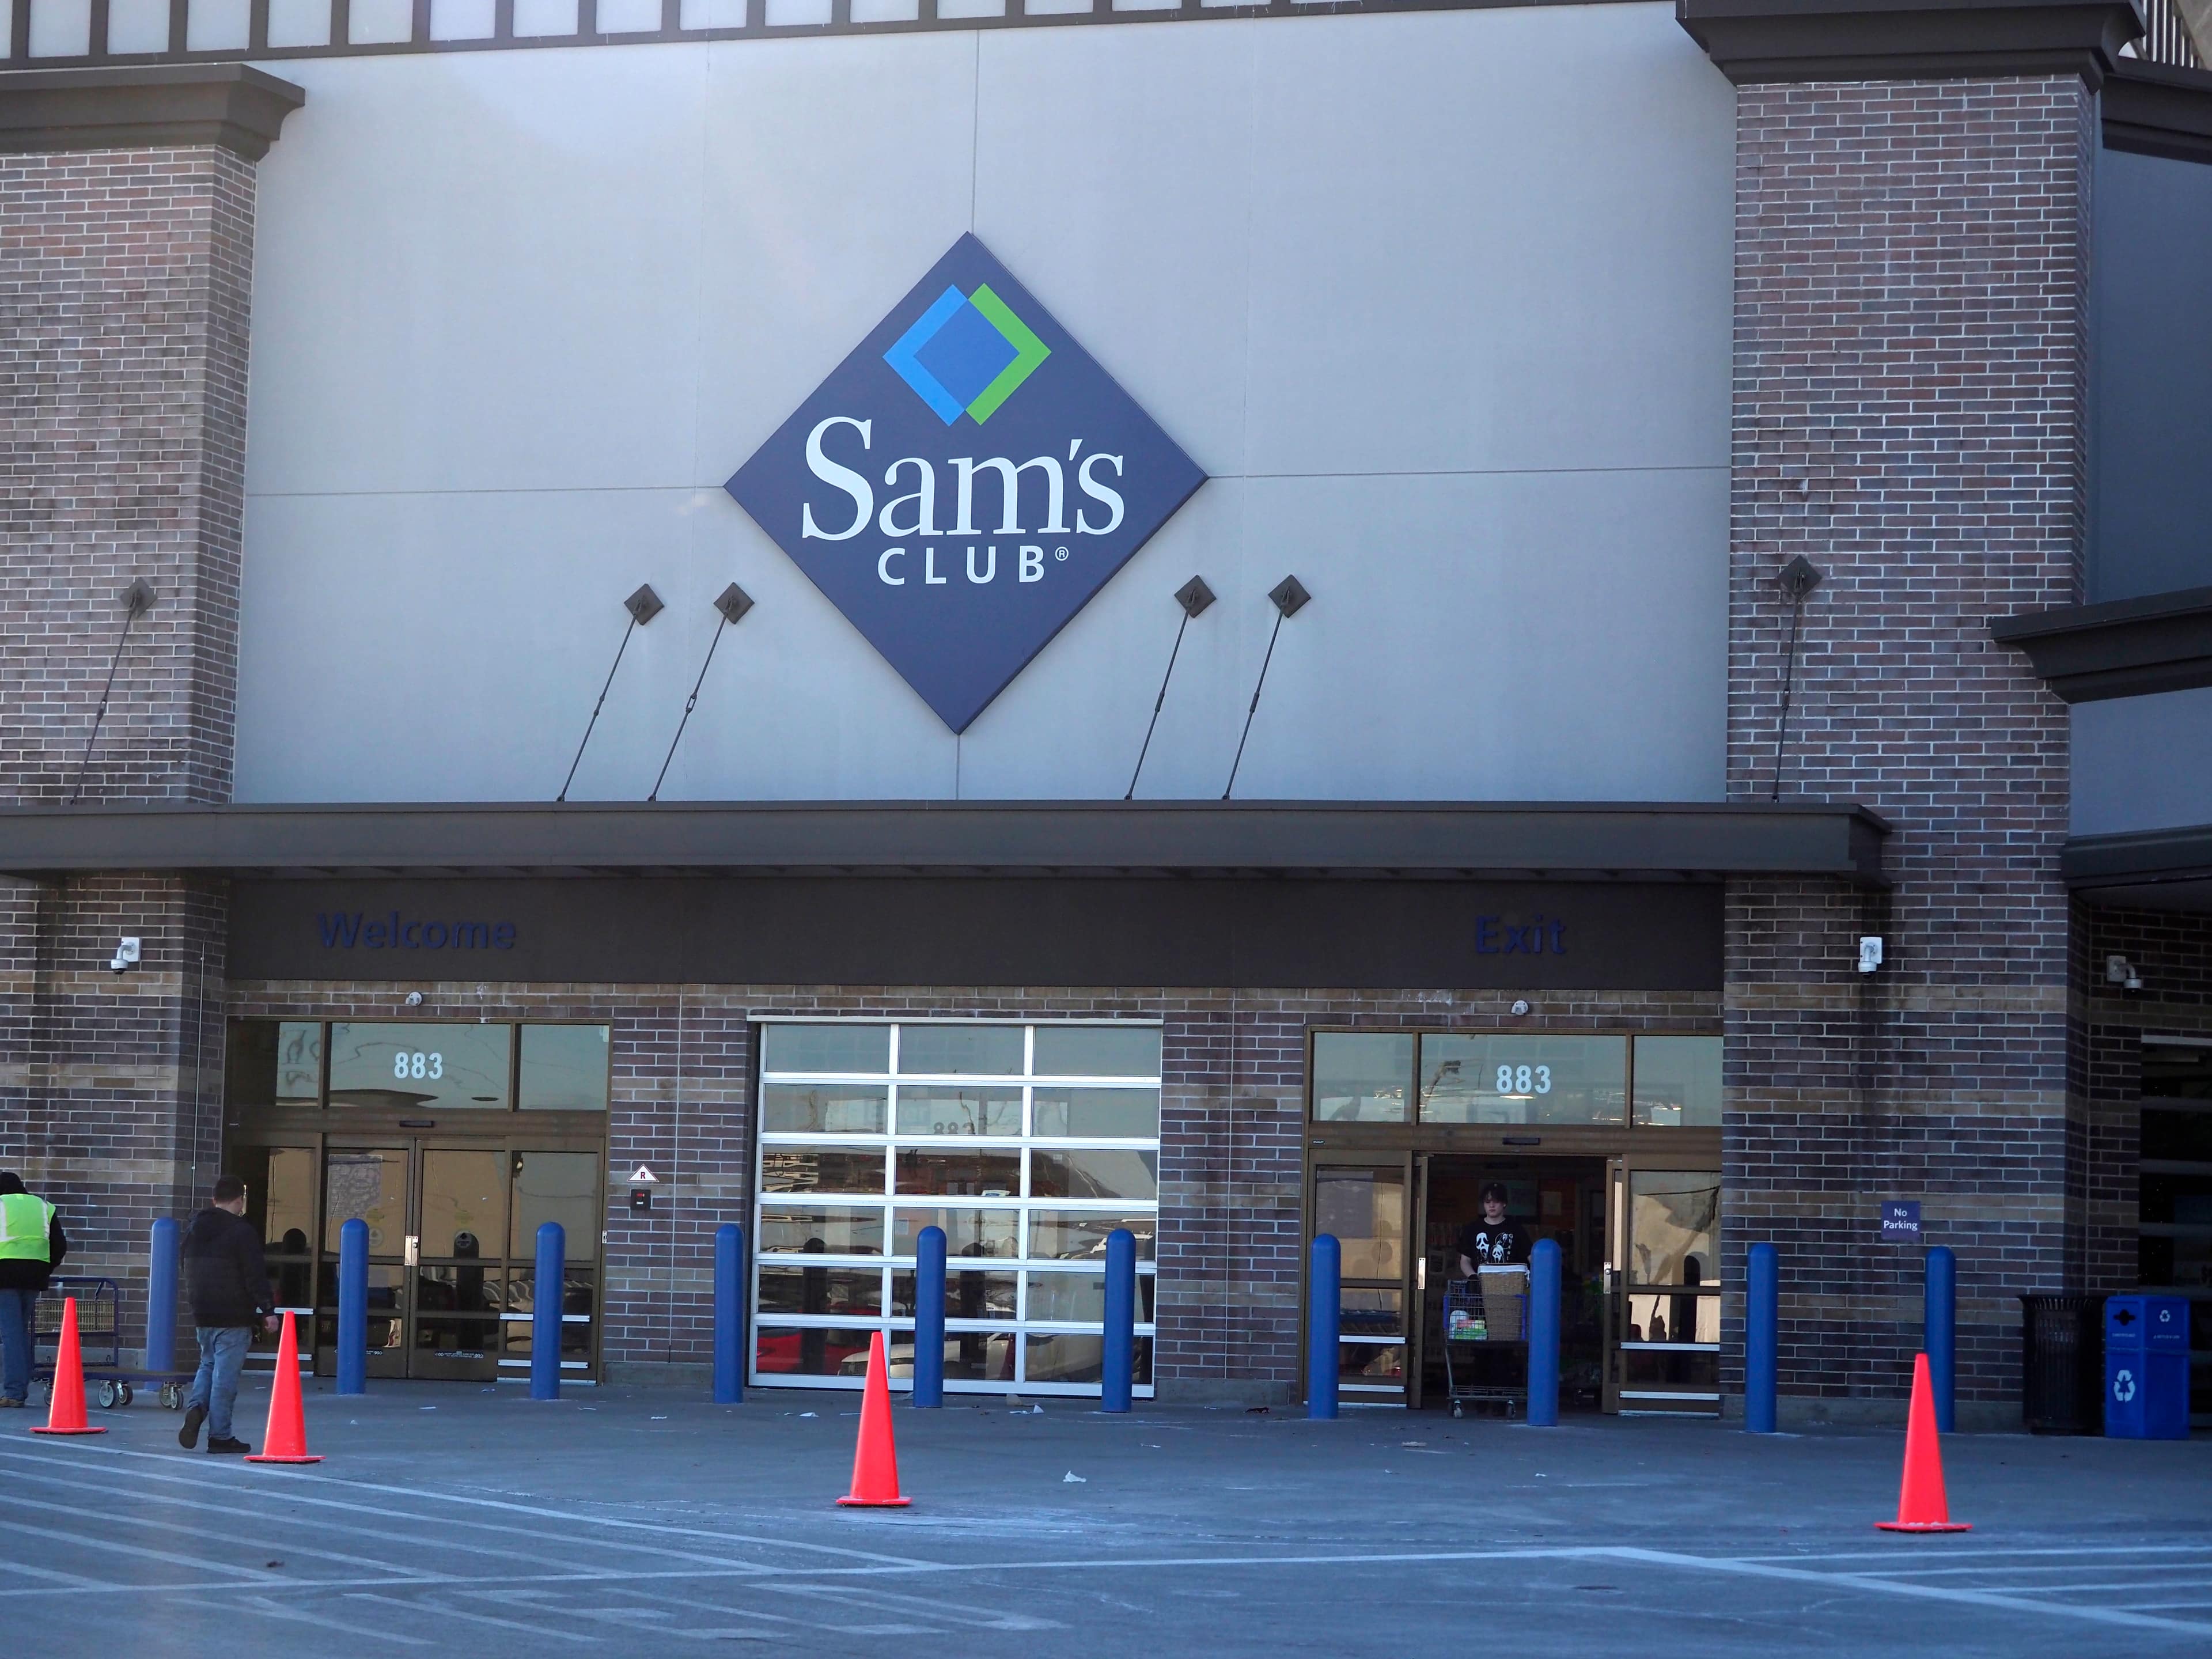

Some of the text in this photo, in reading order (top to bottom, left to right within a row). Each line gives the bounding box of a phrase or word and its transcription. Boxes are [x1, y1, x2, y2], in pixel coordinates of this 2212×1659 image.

[802, 416, 1125, 541] Sam's
[317, 910, 516, 949] Welcome
[1476, 914, 1566, 954] Exit
[394, 1052, 443, 1079] 883
[1496, 1065, 1551, 1094] 883
[1883, 1220, 1918, 1231] Parking
[1894, 1208, 1908, 1217] No
